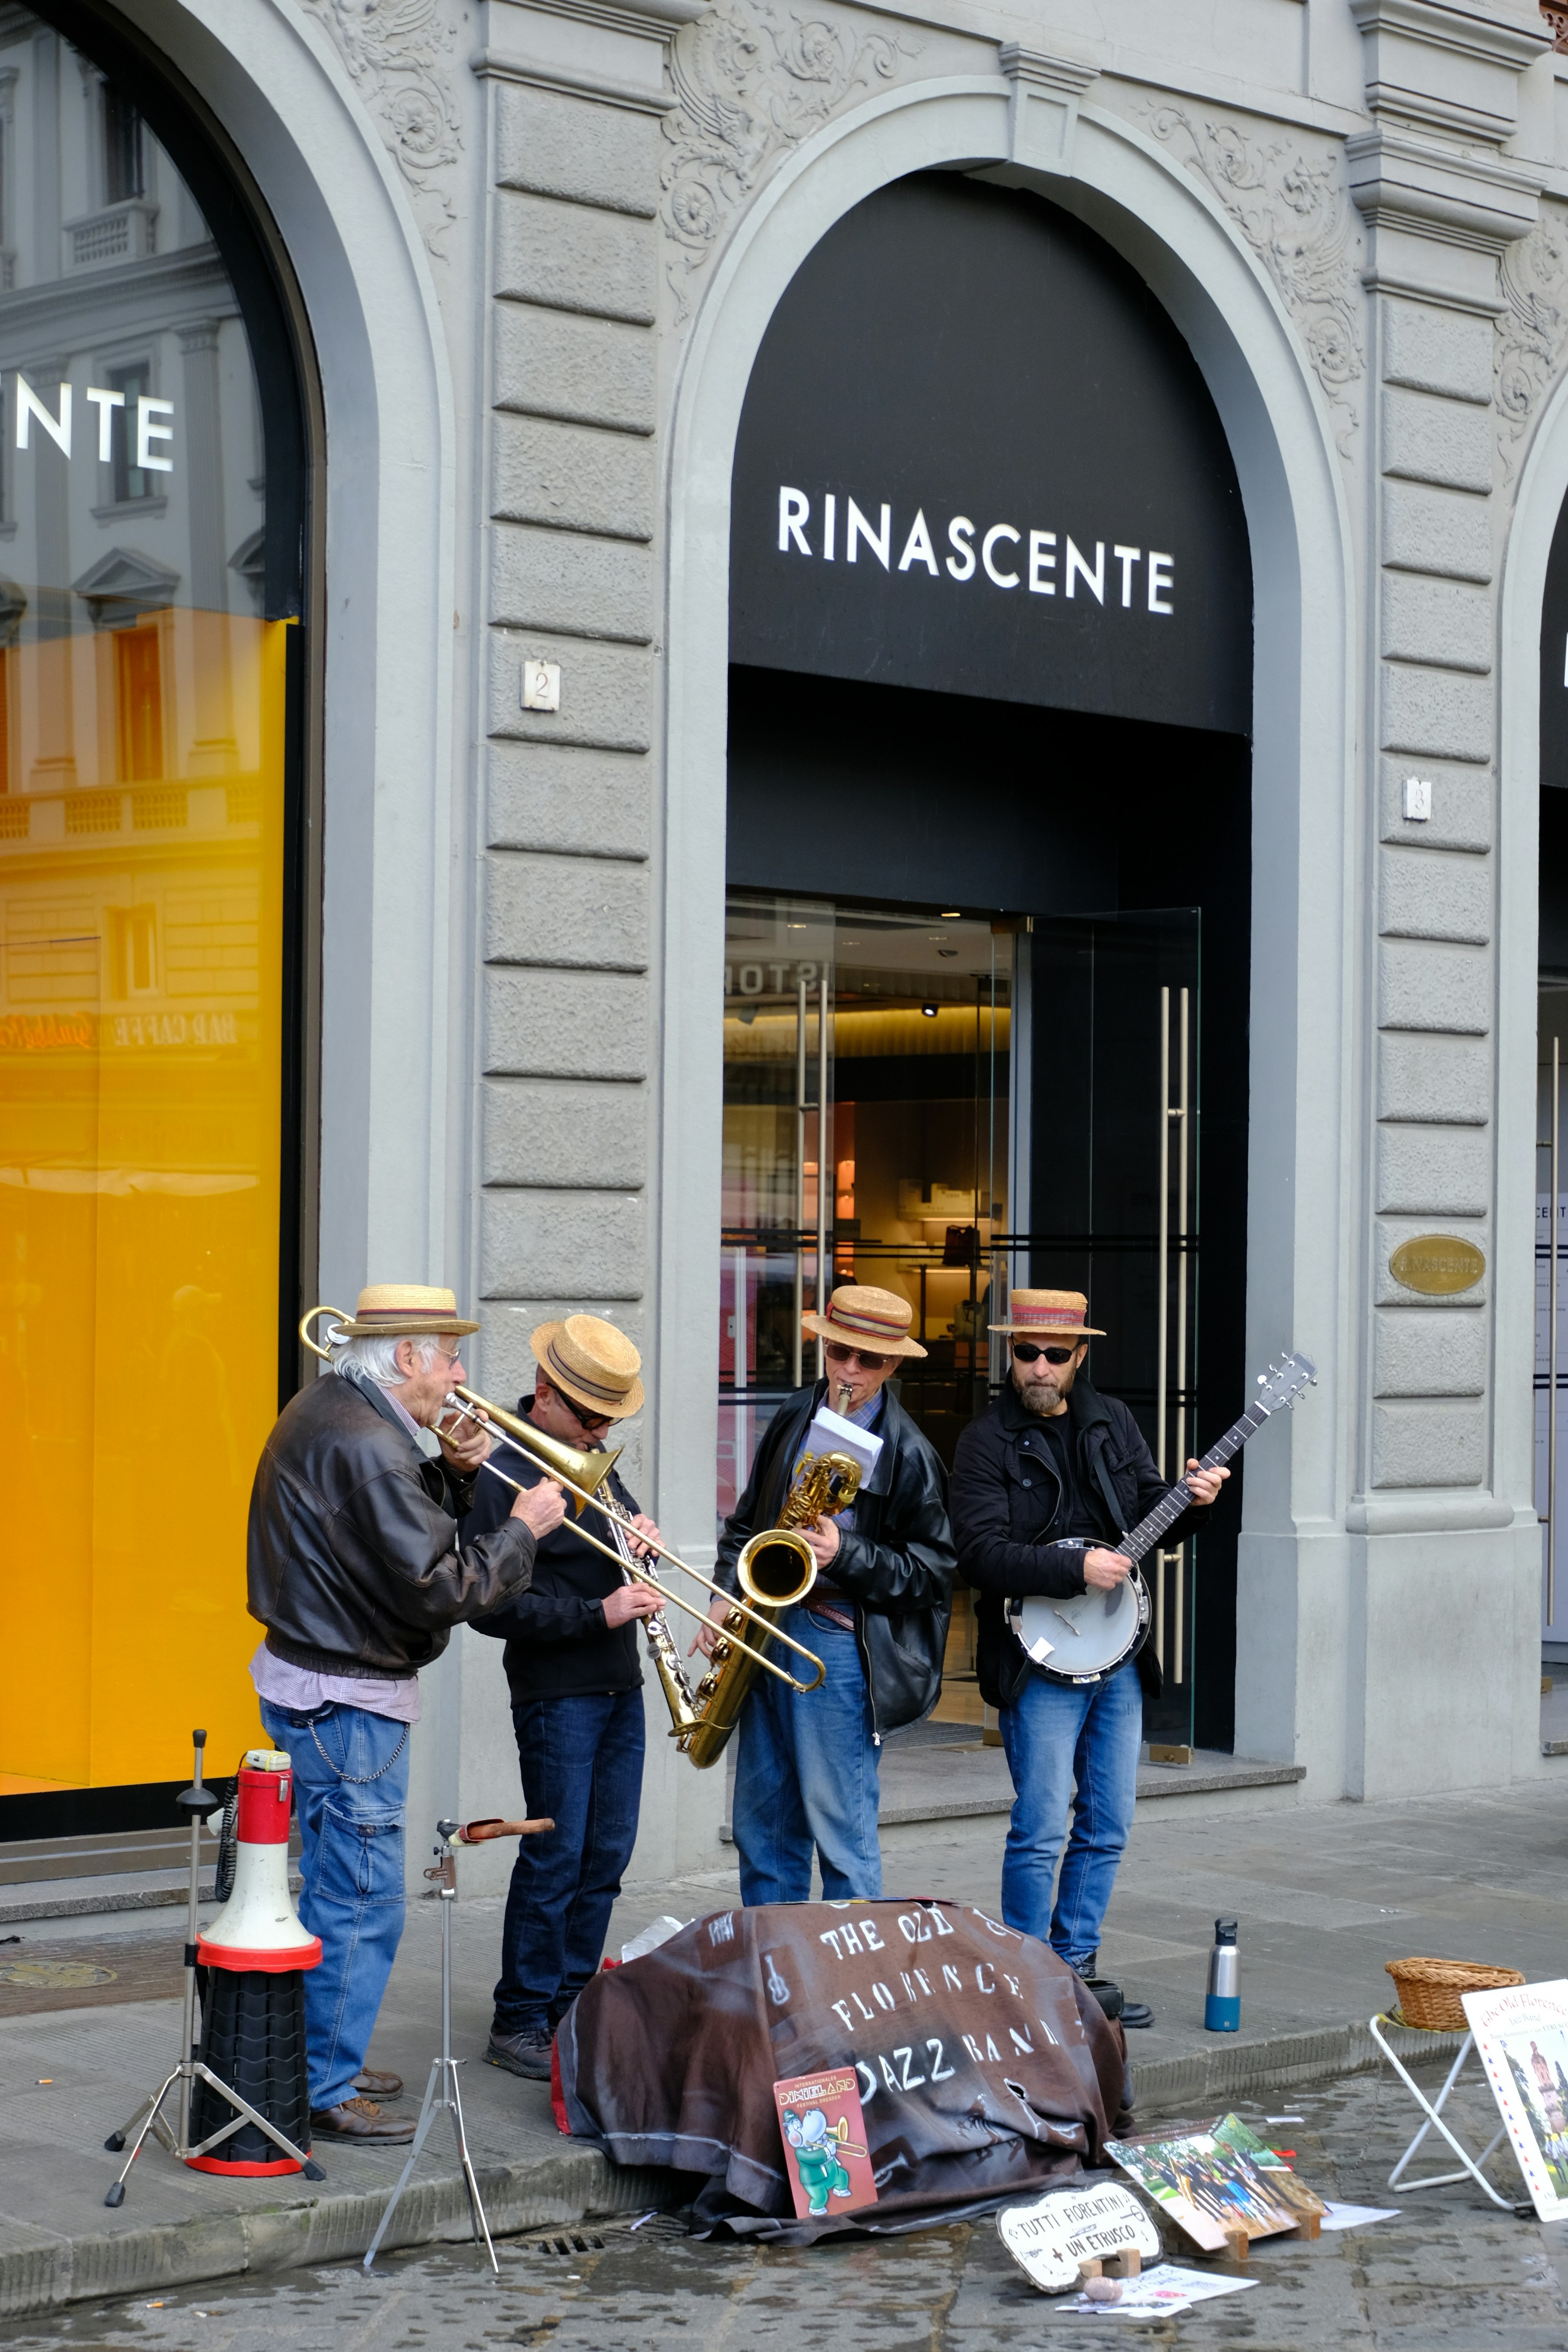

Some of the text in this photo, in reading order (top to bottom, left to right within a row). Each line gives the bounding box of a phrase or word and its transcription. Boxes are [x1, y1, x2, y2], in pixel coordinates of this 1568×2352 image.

[778, 485, 1174, 615] RINASCENTE
[536, 672, 549, 698] 2
[1415, 789, 1424, 811] 3
[1400, 1255, 1478, 1273] RINASCENTE
[820, 1905, 954, 1960] THE OLD
[1499, 1995, 1519, 2011] Old
[1520, 1994, 1567, 2015] Florence
[1522, 2013, 1541, 2022] Band
[794, 2075, 837, 2088] INTERNATIONALES
[855, 2038, 956, 2105] JAZZ
[796, 2095, 842, 2109] FESTIVAL DRESDEN
[1017, 2194, 1124, 2238] TUTTI FIORENTINI
[1065, 2238, 1087, 2258] UN
[1085, 2224, 1136, 2251] ETRUSCO
